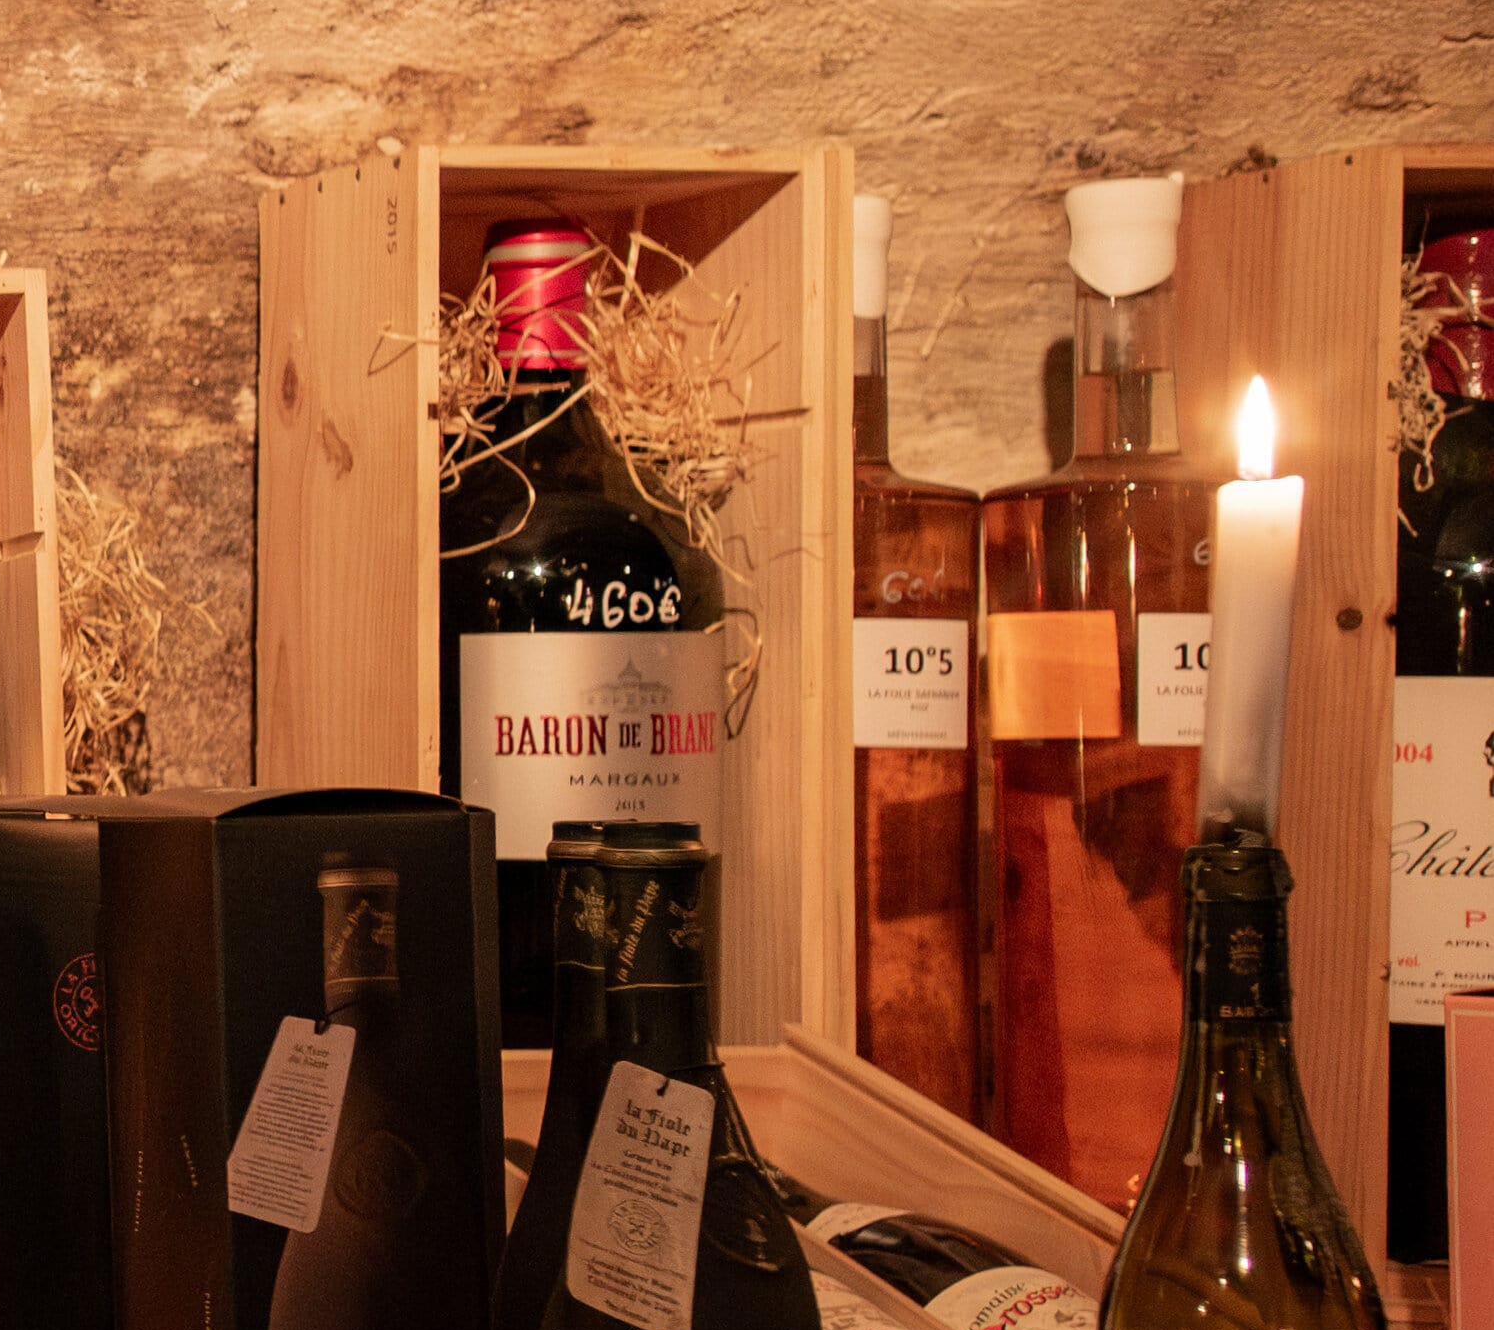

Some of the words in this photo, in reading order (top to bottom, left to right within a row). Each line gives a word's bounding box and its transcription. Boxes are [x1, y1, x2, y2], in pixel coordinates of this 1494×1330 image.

[569, 578, 682, 629] 460€
[884, 646, 953, 676] 10°5
[494, 713, 609, 757] BARON
[619, 720, 641, 749] DE
[569, 771, 682, 787] MARGAUX
